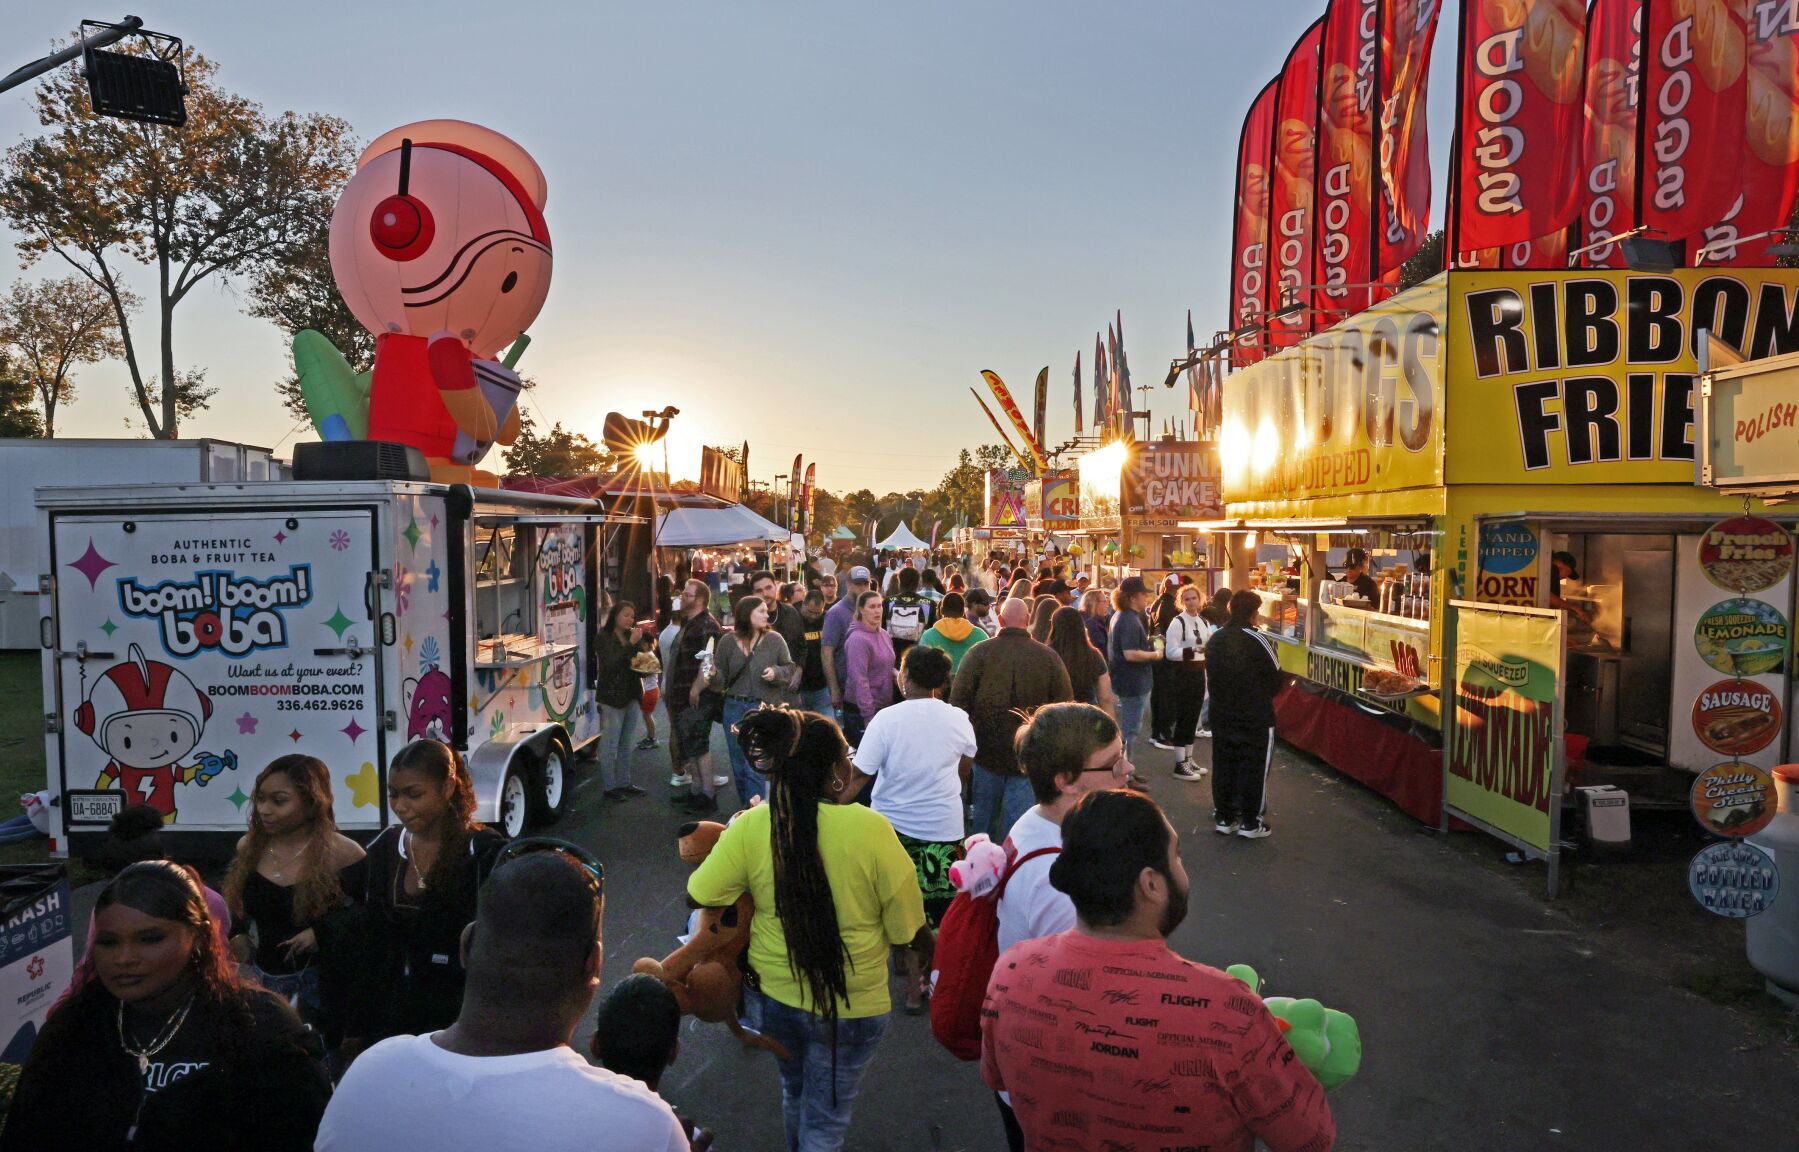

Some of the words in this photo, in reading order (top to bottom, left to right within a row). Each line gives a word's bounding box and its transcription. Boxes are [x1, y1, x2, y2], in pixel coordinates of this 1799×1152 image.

[1307, 311, 1438, 453] DOGS
[1513, 371, 1695, 471] FRIE
[1735, 403, 1799, 443] POLISH
[1303, 448, 1371, 490] DIPPED
[174, 539, 251, 549] AUTHENTIC
[1709, 531, 1788, 546] French
[152, 555, 187, 564] BOBA
[193, 554, 200, 563] &
[207, 553, 245, 563] FRUIT
[252, 553, 275, 562] TEA
[1719, 546, 1776, 560] Fries
[124, 576, 213, 613] boom!
[219, 570, 307, 609] boom!
[163, 607, 282, 654] boba
[1702, 625, 1786, 640] LEMONADE
[228, 665, 262, 678] Want
[265, 669, 279, 677] us
[281, 665, 293, 677] at
[296, 668, 323, 683] your
[326, 664, 363, 677] event?
[1308, 651, 1350, 688] CHICKEN
[1482, 656, 1527, 681] SQUEEZED
[208, 685, 364, 696] BOOMBOOMBOBA.COM
[277, 701, 364, 711] 336.462.9626
[1700, 692, 1772, 713] SAUSAGE
[1449, 678, 1553, 816] LEMONADE
[1705, 773, 1756, 788] Philly
[1705, 783, 1768, 799] Cheese
[1696, 864, 1773, 891] BOTTLED
[1703, 888, 1765, 912] WATER
[17, 982, 52, 1005] REPUBLIC
[1160, 993, 1211, 1009] FLIGHT
[1125, 1016, 1159, 1028] FLIGHT
[1090, 1041, 1139, 1059] JORDAN
[1157, 1032, 1196, 1043] OFFICIAL
[1199, 1036, 1233, 1049] MEMBER
